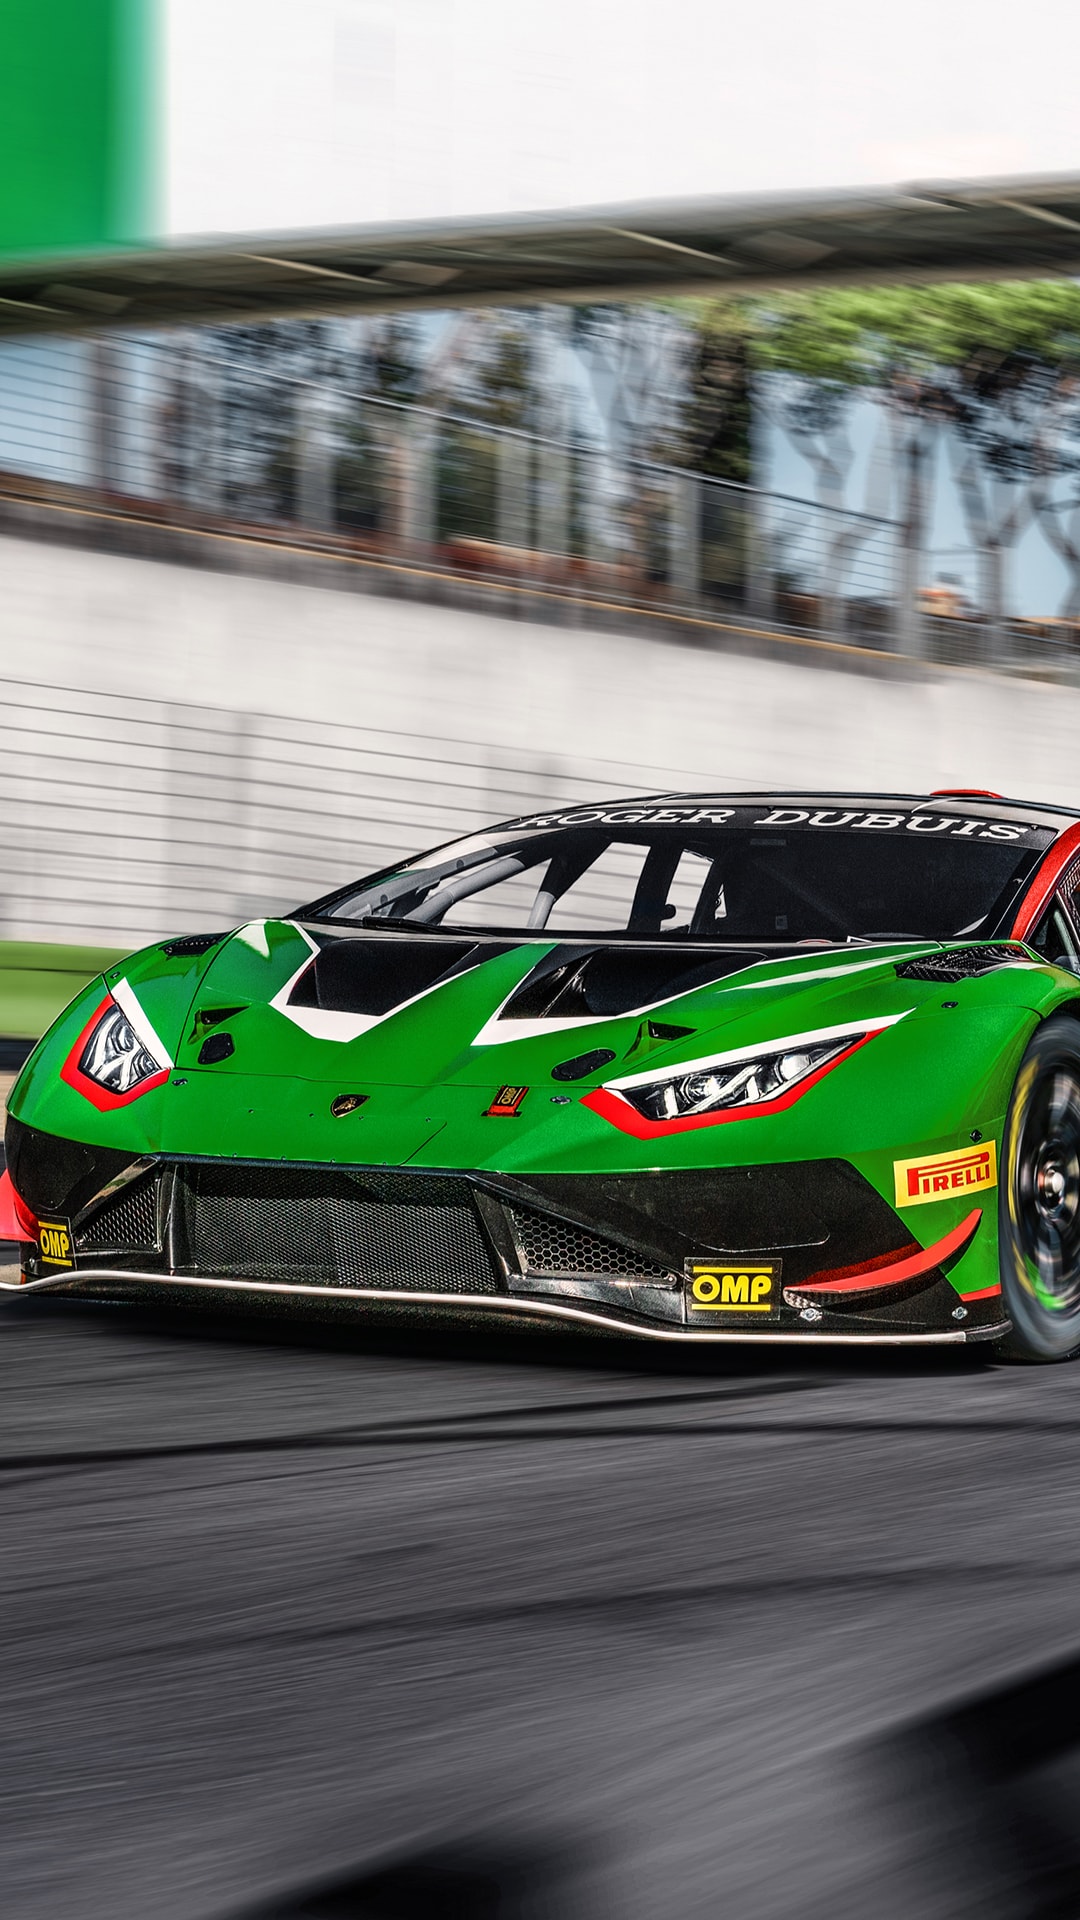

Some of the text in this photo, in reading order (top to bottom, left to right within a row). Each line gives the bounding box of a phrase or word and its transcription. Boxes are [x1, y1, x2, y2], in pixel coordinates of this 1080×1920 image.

[508, 809, 1028, 840] ROGER DUBUIS
[906, 1151, 990, 1197] PIRELLI
[40, 1228, 70, 1259] OMP
[692, 1274, 772, 1304] OMP
